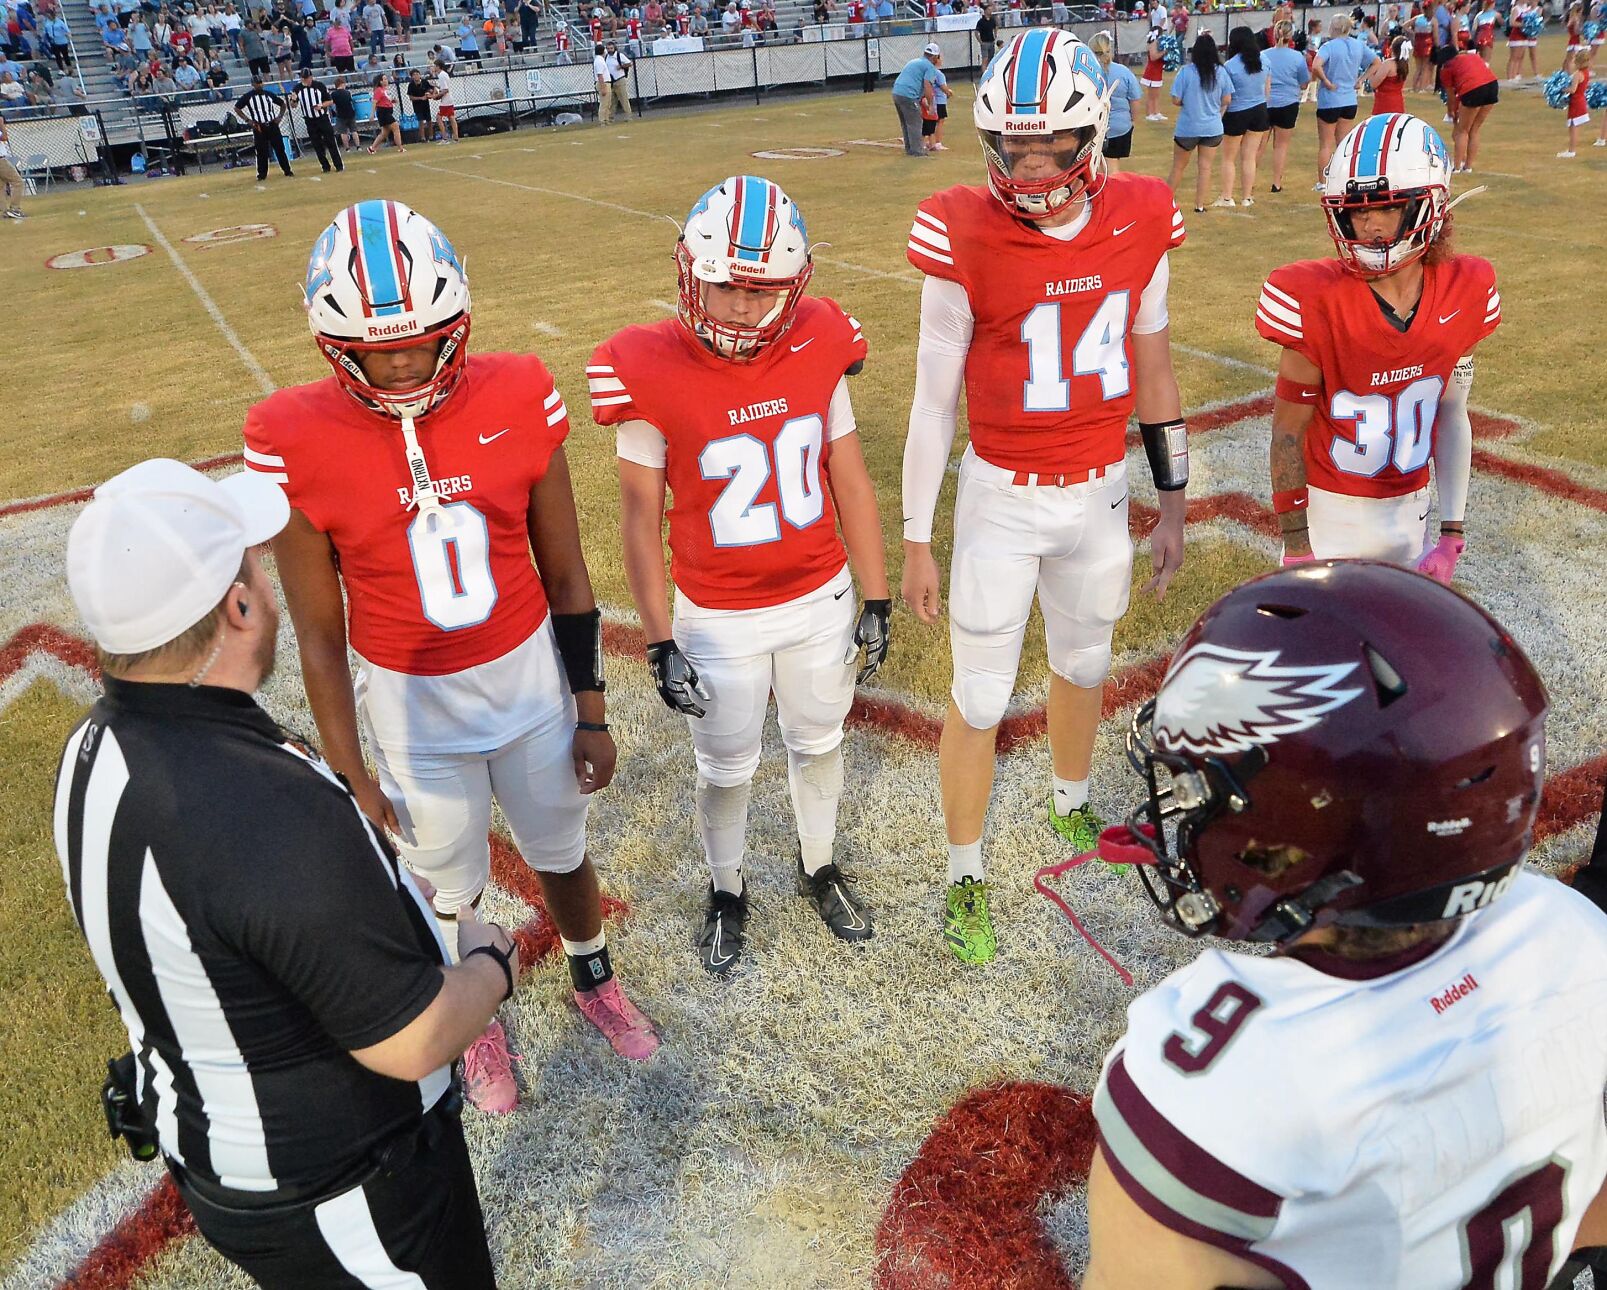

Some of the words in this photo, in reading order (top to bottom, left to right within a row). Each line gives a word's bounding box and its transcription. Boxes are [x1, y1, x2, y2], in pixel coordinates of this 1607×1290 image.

[528, 71, 538, 80] 40
[81, 117, 96, 128] 50
[1005, 121, 1046, 130] Riddell
[730, 262, 766, 274] Riddell
[1046, 275, 1103, 296] RAIDERS
[368, 320, 417, 337] Riddell
[1021, 288, 1130, 412] 14
[1370, 364, 1424, 386] RAIDERS
[727, 398, 789, 425] RAIDERS
[1329, 375, 1444, 478] 30
[411, 458, 430, 490] NXTRND
[698, 413, 824, 547] 20
[397, 475, 473, 504] RADERS
[406, 500, 498, 632] 0
[1430, 973, 1479, 1015] Riddell
[1161, 979, 1267, 1078] 9
